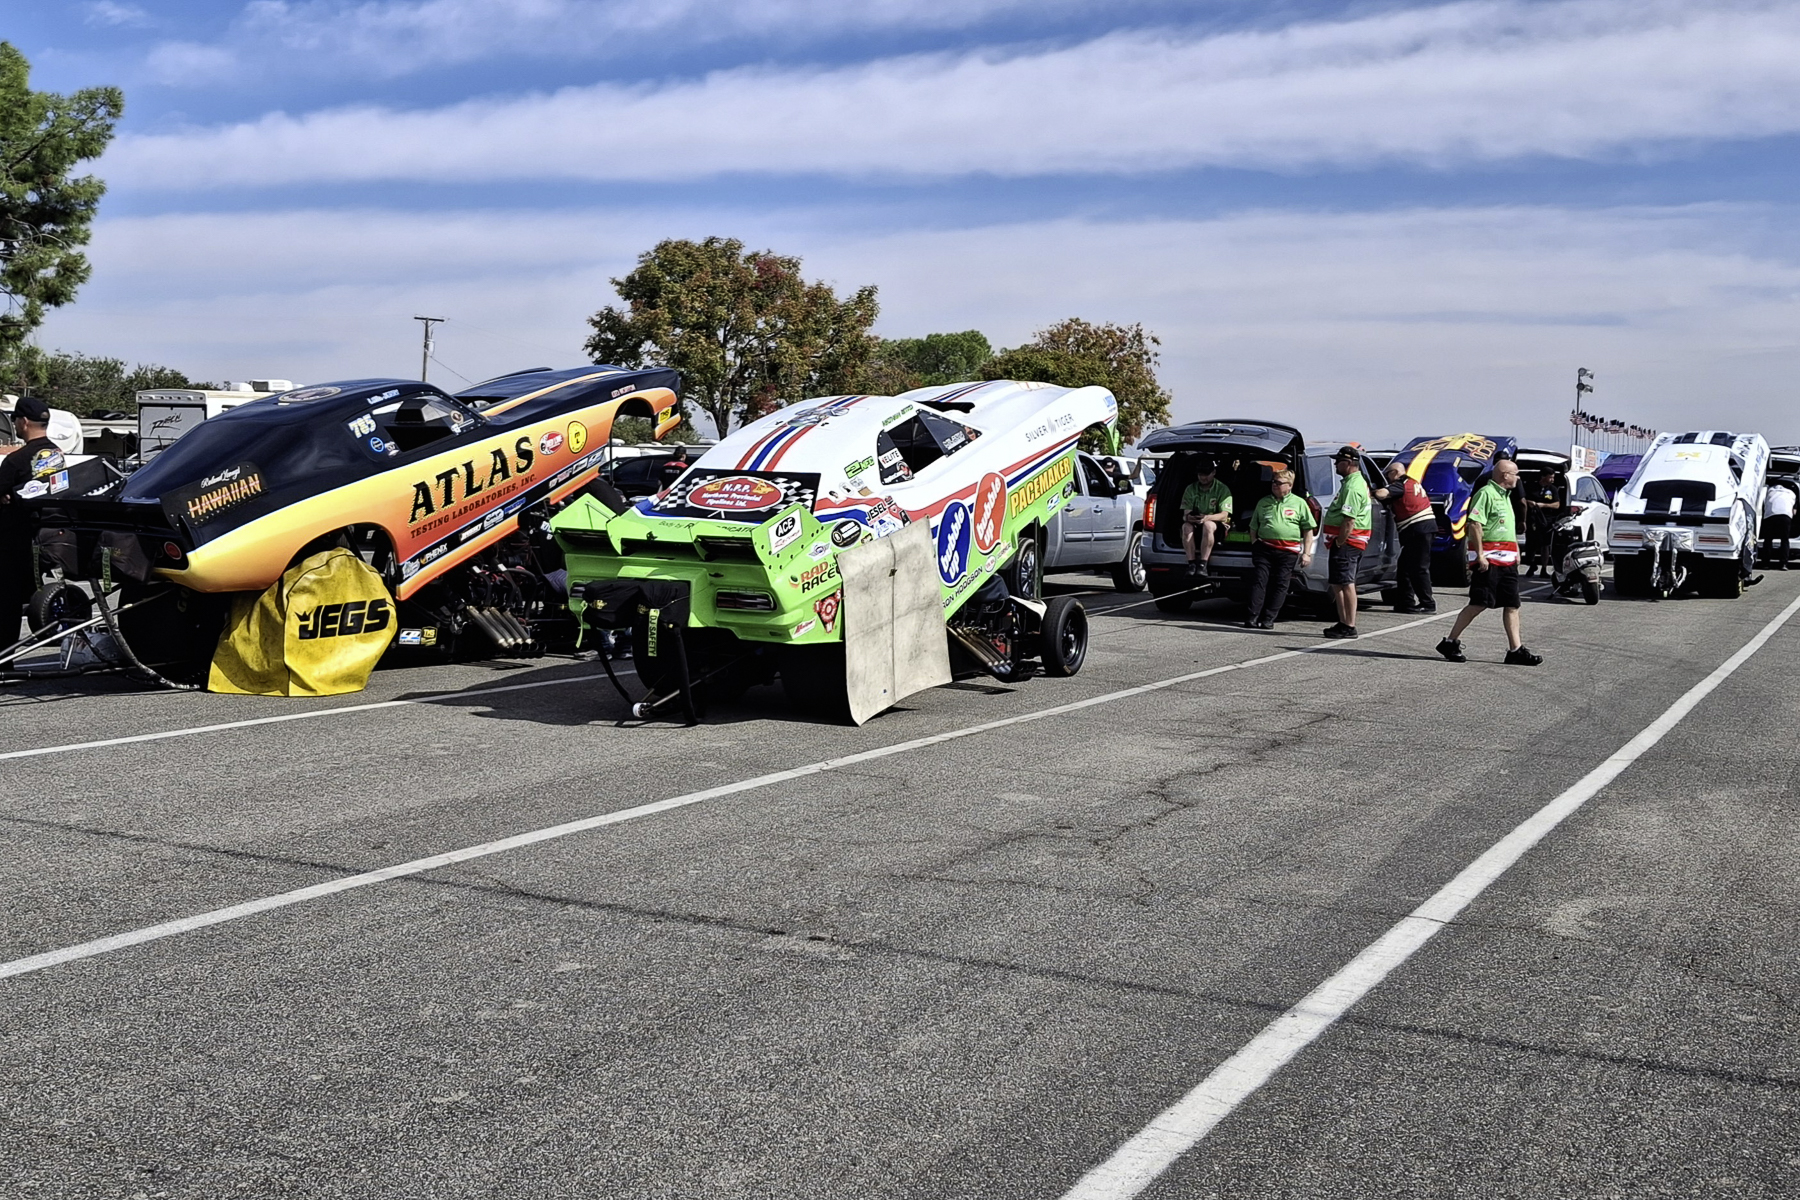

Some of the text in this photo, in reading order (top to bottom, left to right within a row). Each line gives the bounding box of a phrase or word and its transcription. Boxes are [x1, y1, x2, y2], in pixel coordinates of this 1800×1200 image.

[1025, 424, 1048, 442] SILVER
[1054, 413, 1075, 430] TIGER
[884, 450, 900, 464] ELITE
[408, 436, 535, 525] ATLAS
[722, 483, 751, 493] N.P.P.
[1010, 457, 1071, 520] PACEMAKER
[188, 473, 261, 518] HAWAIIAN
[410, 512, 450, 539] TESTING
[452, 483, 518, 520] LABORATORIES,
[521, 474, 537, 487] INC.
[730, 493, 763, 502] Provincial
[976, 476, 1001, 541] bubble
[866, 502, 887, 521] JESEL
[778, 517, 793, 536] ACE
[940, 507, 965, 574] bubble
[984, 518, 995, 547] up
[801, 562, 828, 583] RAD
[949, 550, 960, 580] up
[955, 566, 983, 597] HODGSON
[298, 598, 391, 640] JEGS
[648, 626, 657, 655] SAFETY
